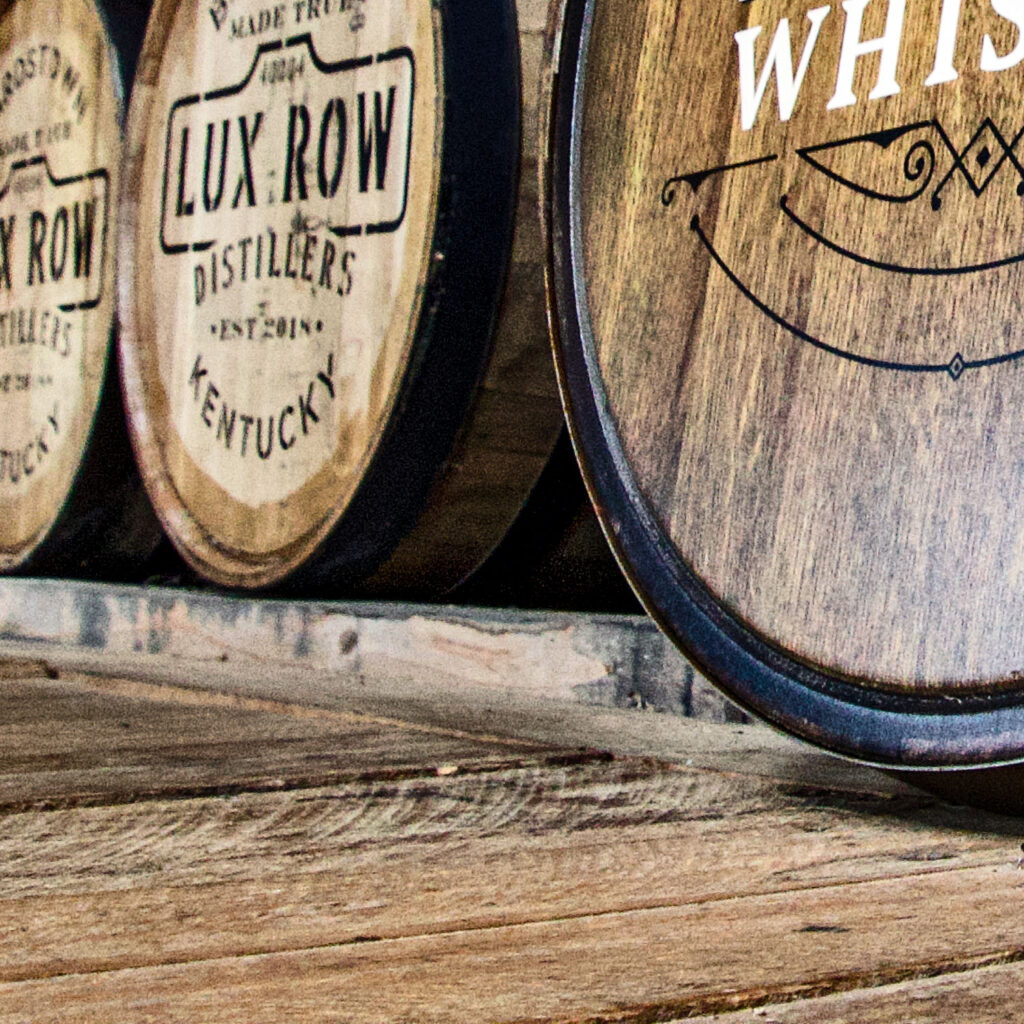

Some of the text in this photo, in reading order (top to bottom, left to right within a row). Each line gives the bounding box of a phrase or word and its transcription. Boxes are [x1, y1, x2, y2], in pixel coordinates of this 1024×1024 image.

[228, 2, 288, 41] MADE
[176, 86, 396, 217] LUX ROW
[27, 197, 98, 287] ROW
[193, 223, 356, 306] DISTILLERS
[189, 345, 336, 460] KENTUCKY
